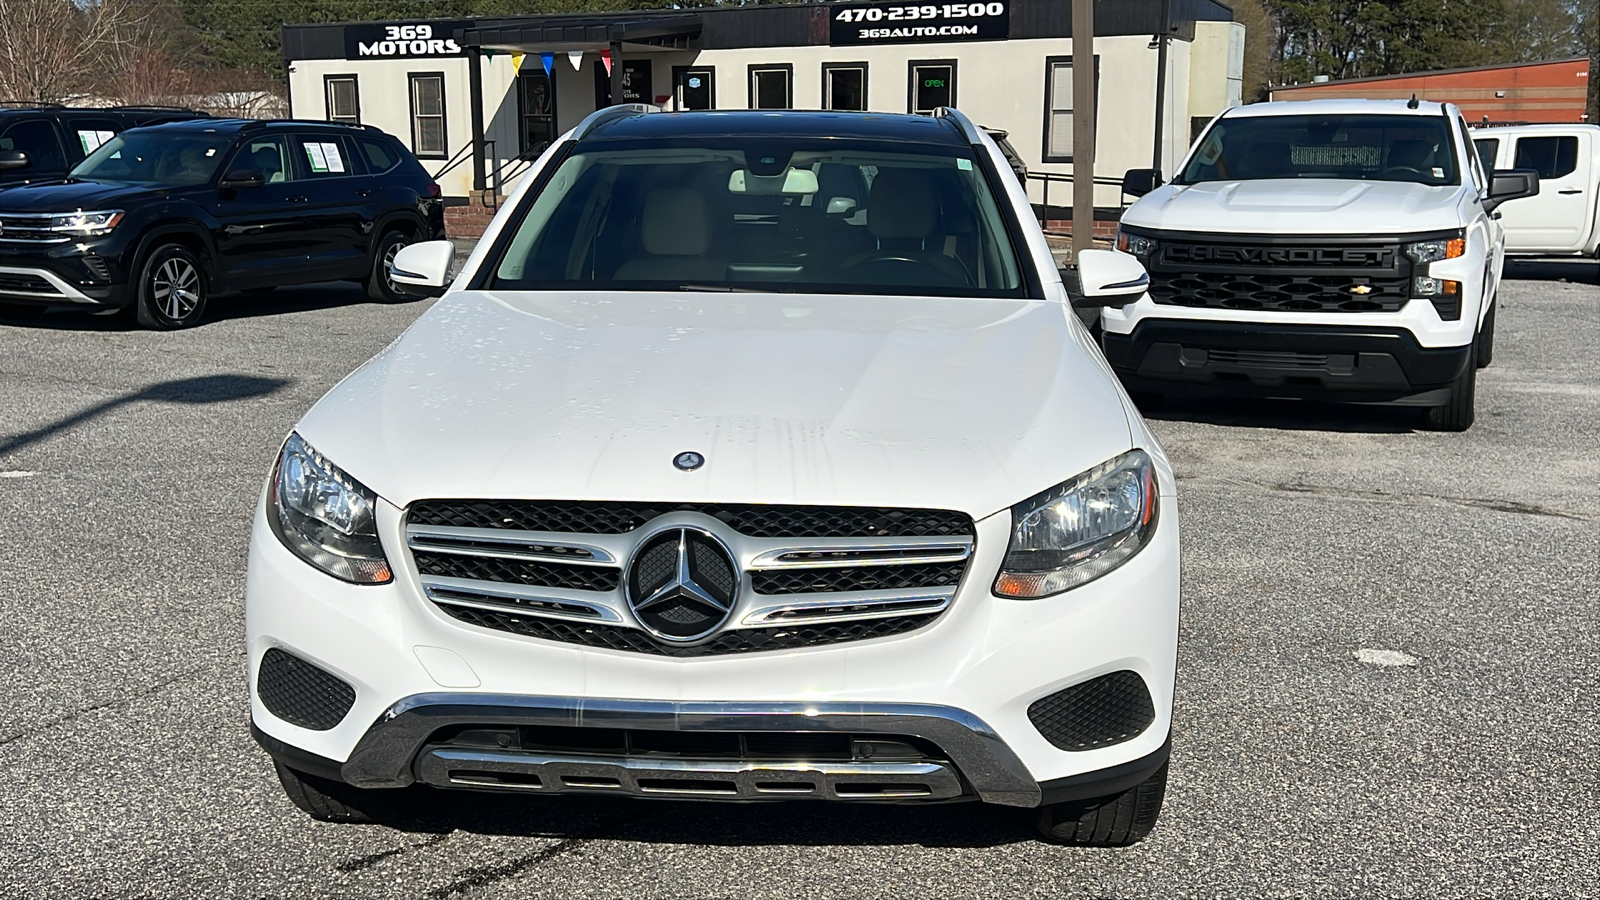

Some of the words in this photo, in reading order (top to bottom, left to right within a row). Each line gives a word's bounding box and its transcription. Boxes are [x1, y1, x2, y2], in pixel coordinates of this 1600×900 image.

[835, 2, 1004, 22] 470-239-1500
[385, 25, 432, 40] 369
[858, 25, 978, 38] 369AUTO.COM
[358, 39, 461, 55] MOTORS
[924, 79, 944, 87] OPEN
[1166, 244, 1393, 263] CHEVROLET
